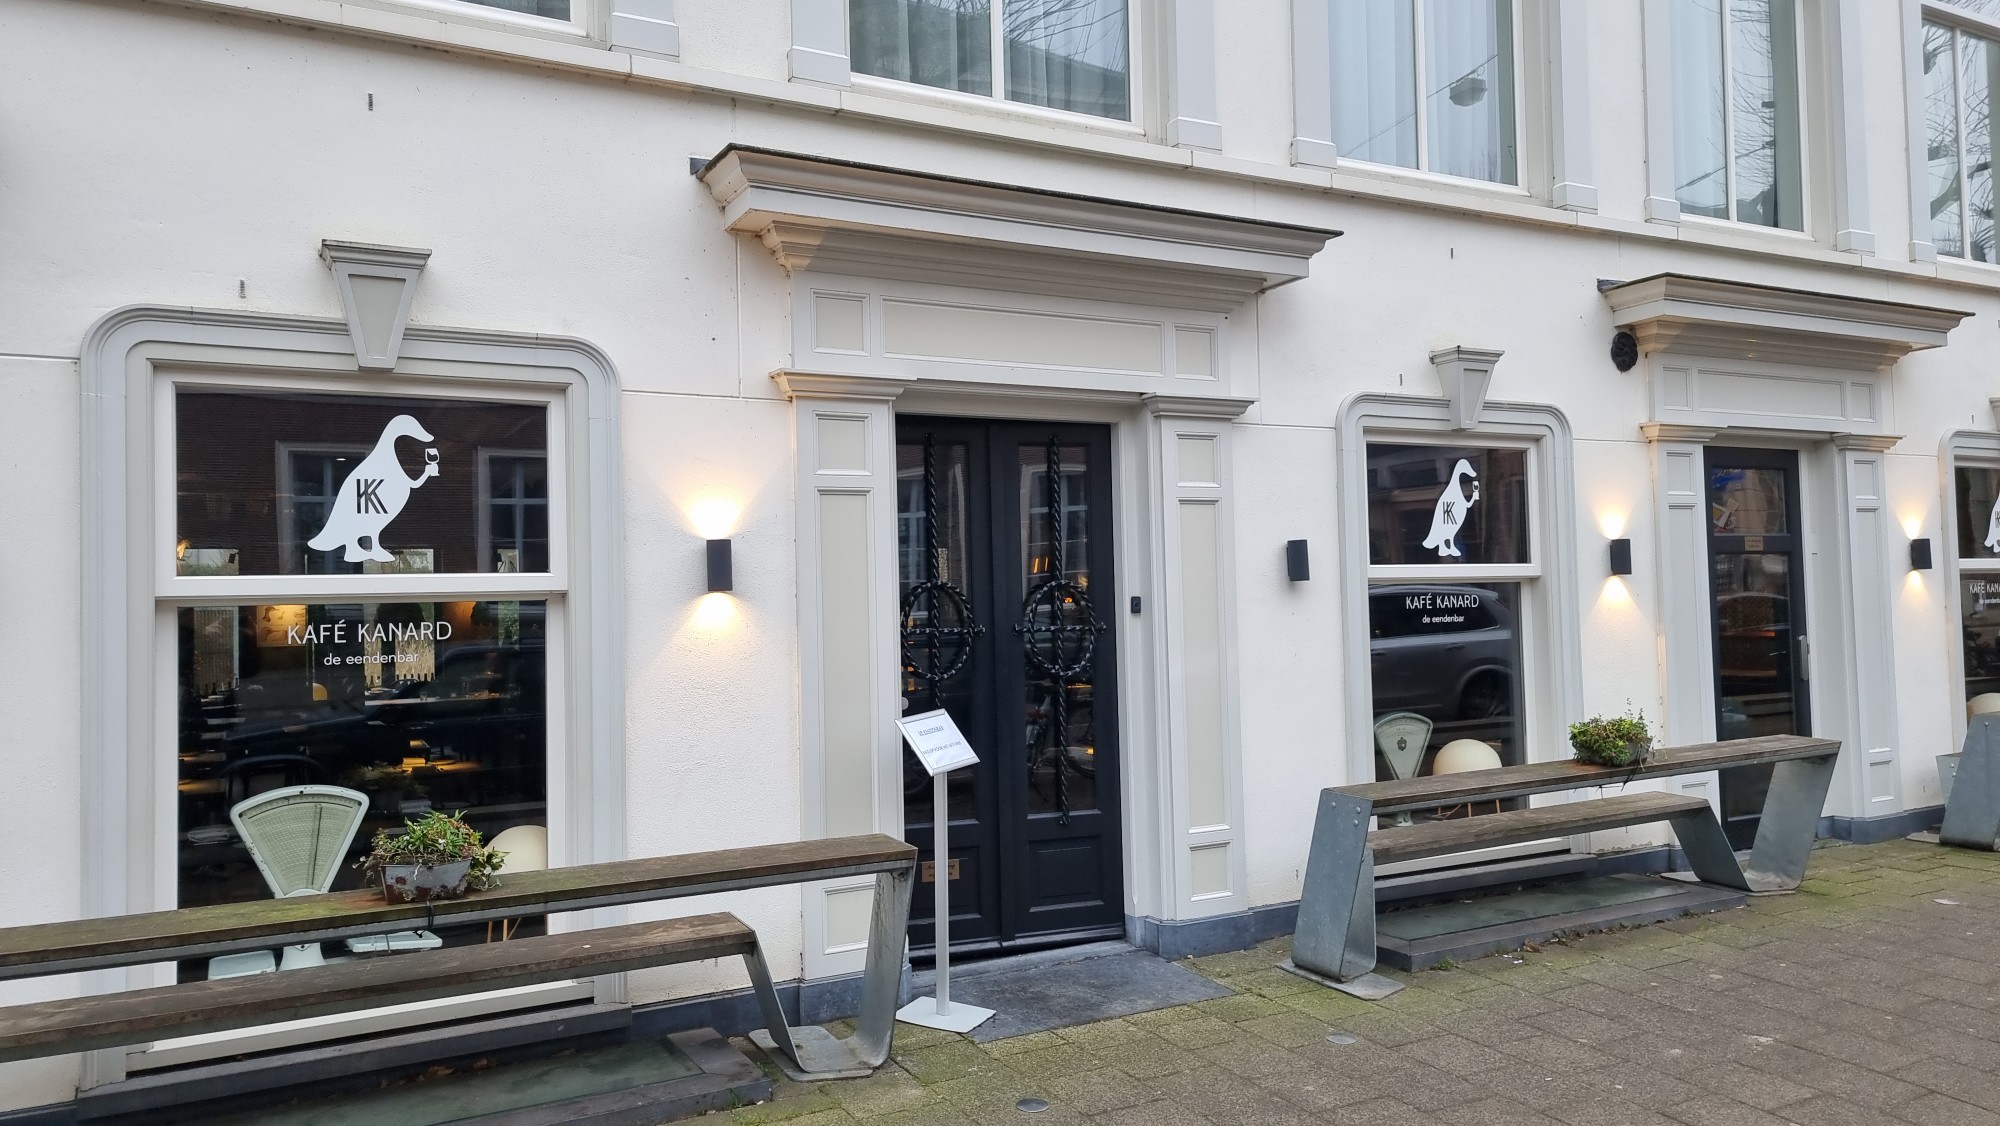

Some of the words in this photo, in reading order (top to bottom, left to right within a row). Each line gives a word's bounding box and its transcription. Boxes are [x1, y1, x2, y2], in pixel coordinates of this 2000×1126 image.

[1969, 580, 1985, 594] KAFÉ
[1406, 593, 1432, 609] KAFÉ
[1436, 594, 1479, 609] KANARD
[1422, 614, 1431, 624] de
[1432, 614, 1464, 623] eendenbar
[288, 619, 347, 644] KAFÉ
[358, 621, 452, 643] KANARD
[323, 653, 341, 666] de
[346, 651, 419, 665] eendenbar
